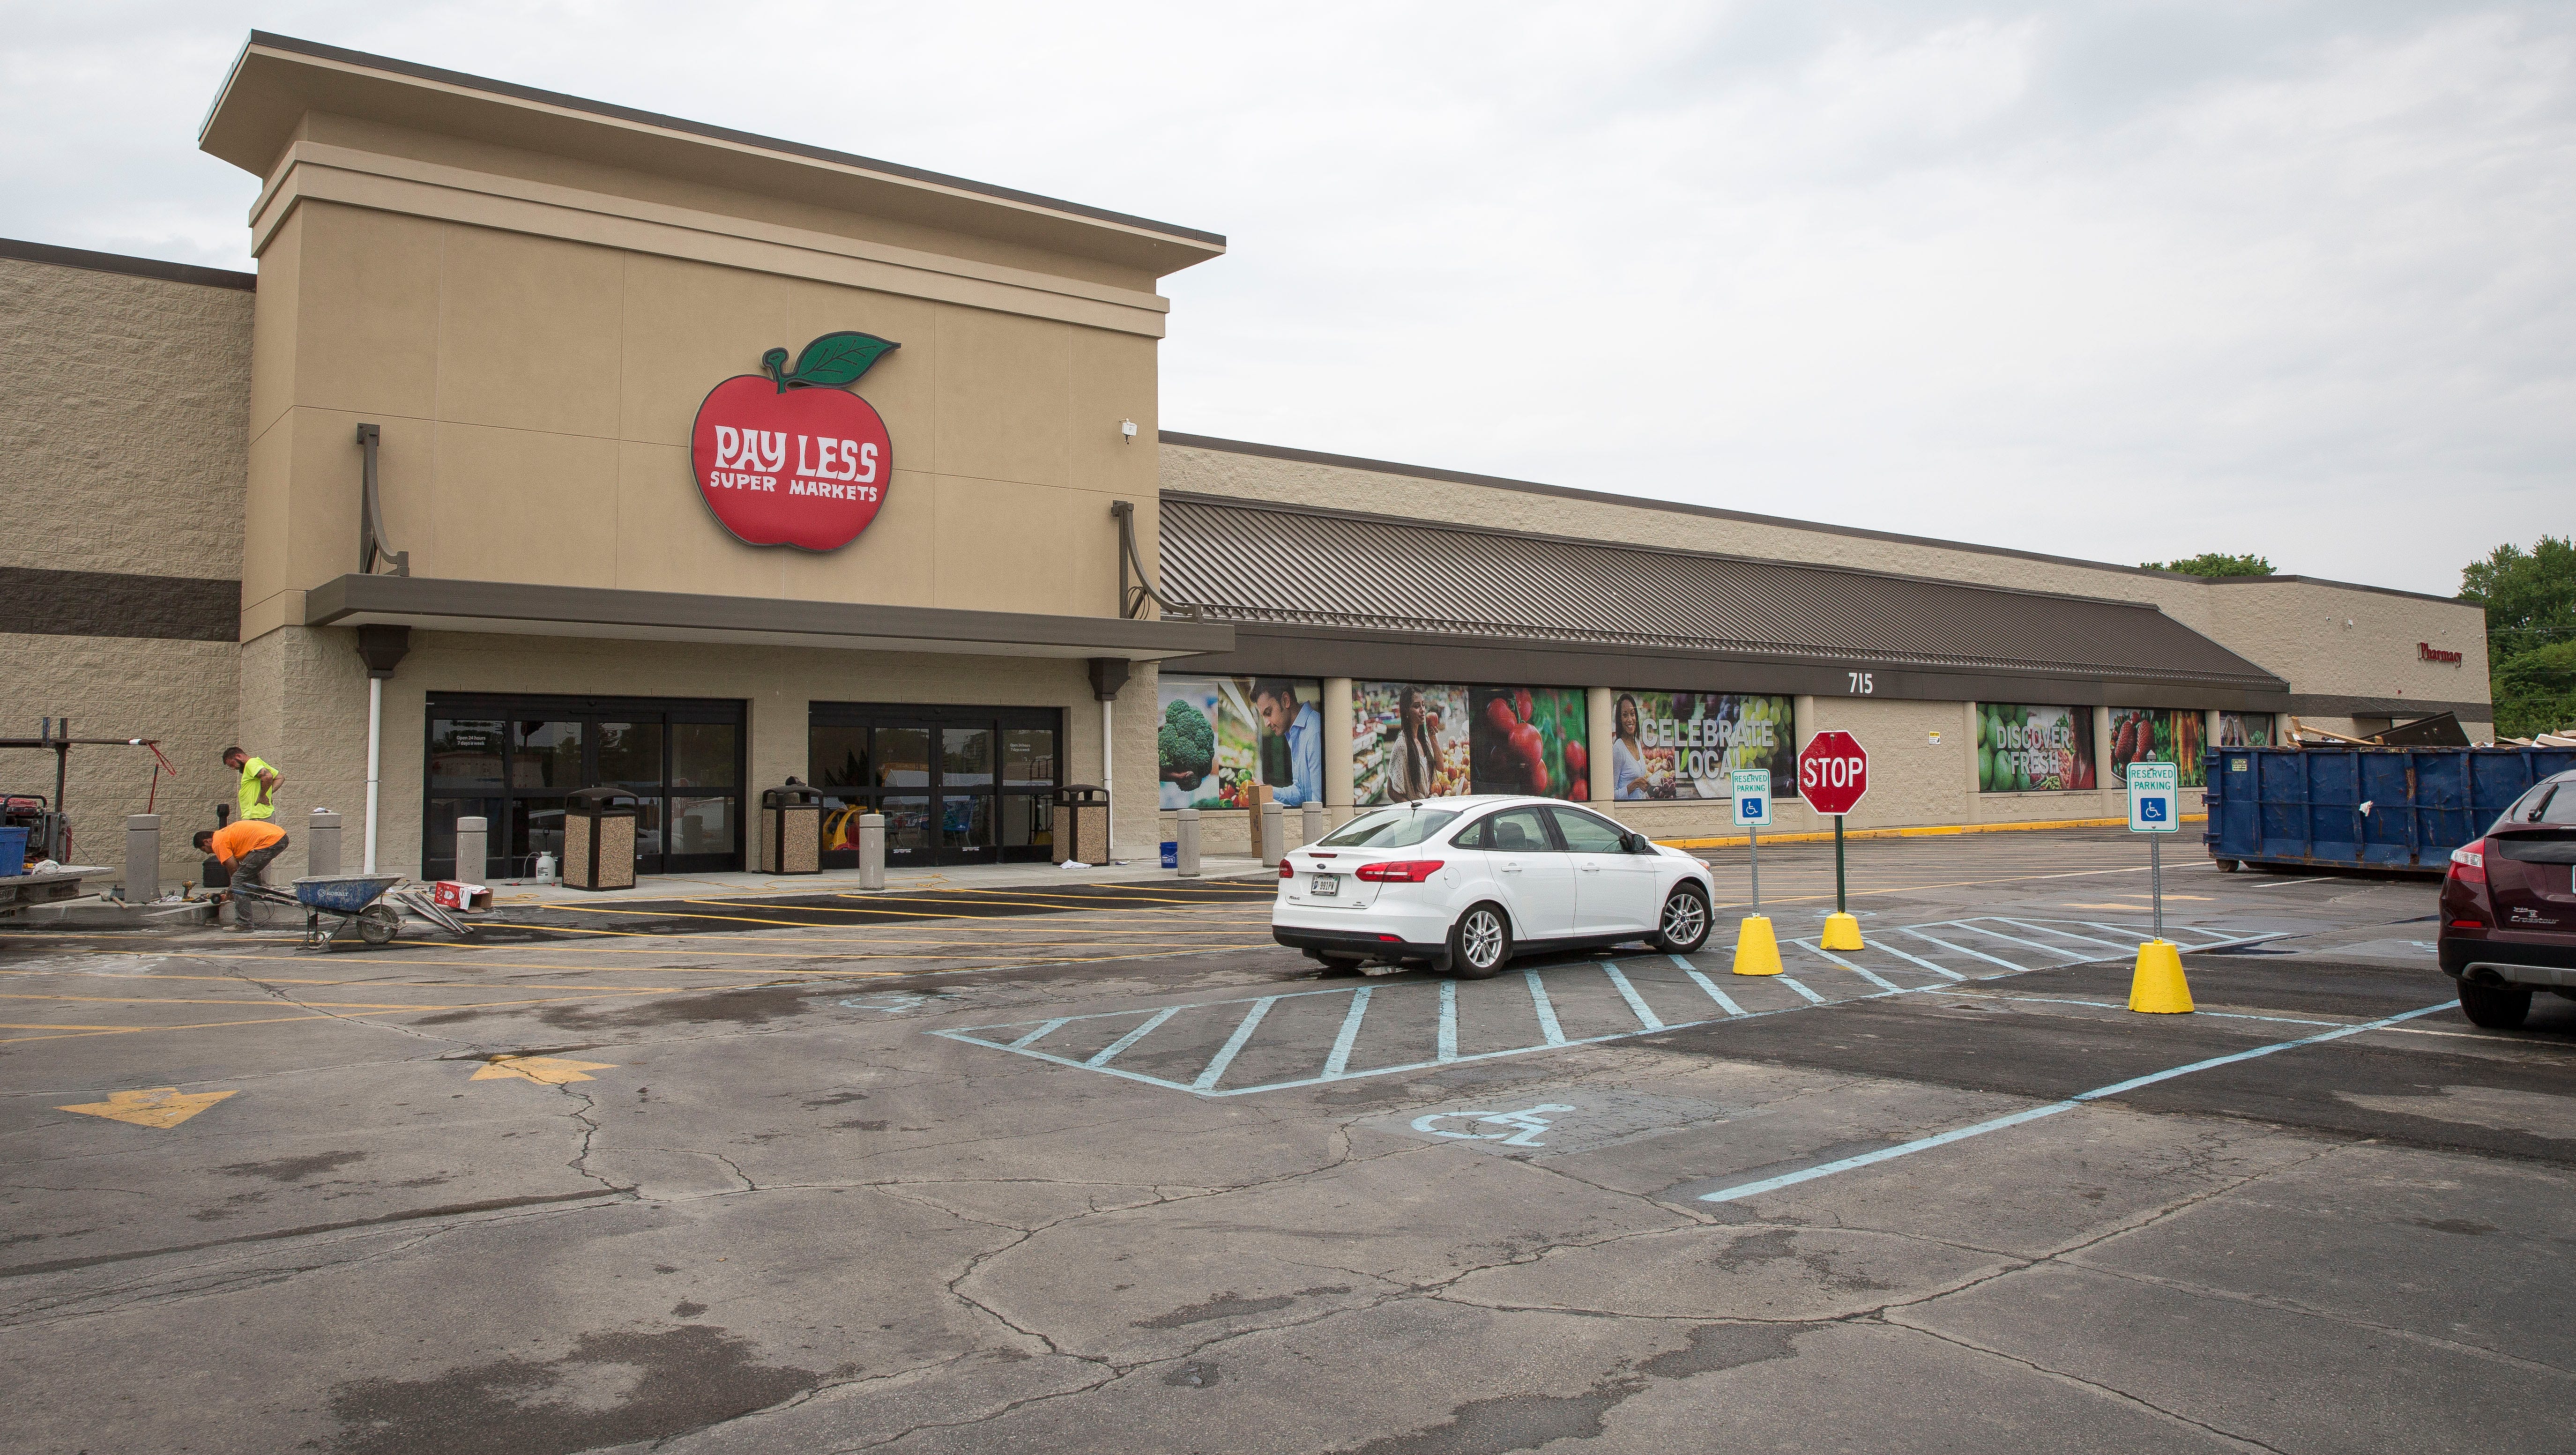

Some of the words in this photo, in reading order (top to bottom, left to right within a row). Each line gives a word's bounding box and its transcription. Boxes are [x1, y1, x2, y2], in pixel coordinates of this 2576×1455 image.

[715, 425, 788, 473] PAY
[796, 435, 879, 483] LESS
[710, 470, 777, 492] SUPER
[789, 479, 878, 502] MARKETS
[2419, 642, 2463, 668] Pharmacy
[1848, 672, 1873, 694] 715
[1642, 718, 1774, 747] CELEBRATE
[1996, 726, 2070, 749] DISCOVER
[1803, 757, 1863, 787] STOP
[2010, 751, 2060, 774] FRESH
[2131, 770, 2173, 778] RESERVED
[2134, 781, 2170, 790] PARKING
